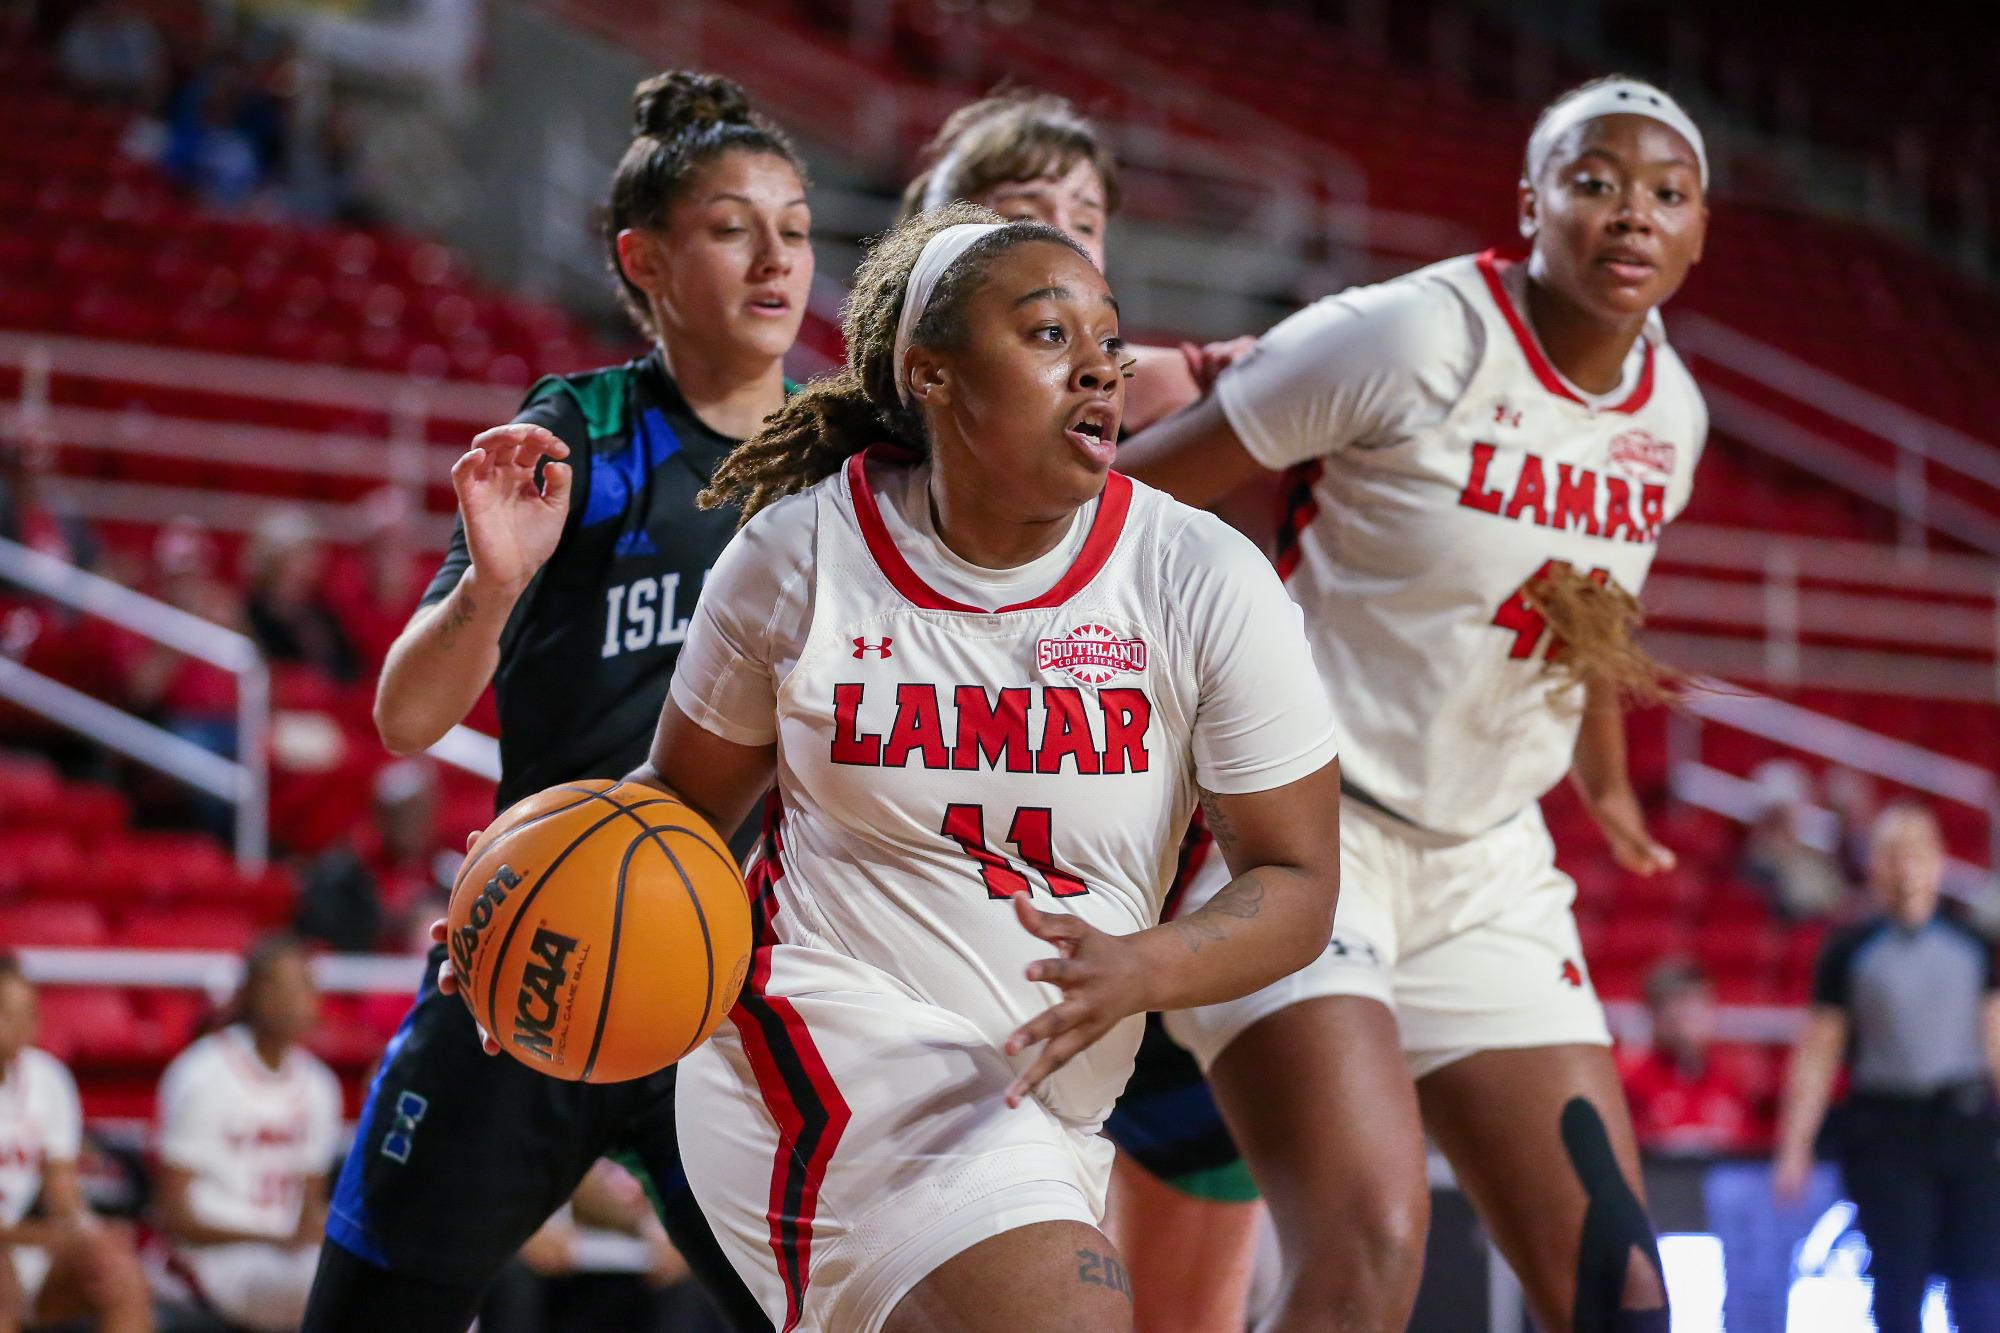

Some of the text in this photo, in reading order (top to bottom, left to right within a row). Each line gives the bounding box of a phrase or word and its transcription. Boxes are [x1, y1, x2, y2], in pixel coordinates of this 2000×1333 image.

[1457, 440, 1666, 544] LAMAR
[600, 568, 712, 659] ISL
[1039, 639, 1146, 670] SOUTHLAND
[1490, 557, 1611, 665] 4
[1057, 655, 1127, 671] CONFERENCE
[830, 682, 1152, 776] LAMAR
[939, 802, 1091, 900] 11
[511, 926, 581, 1062] NCAA
[572, 943, 592, 981] BALL
